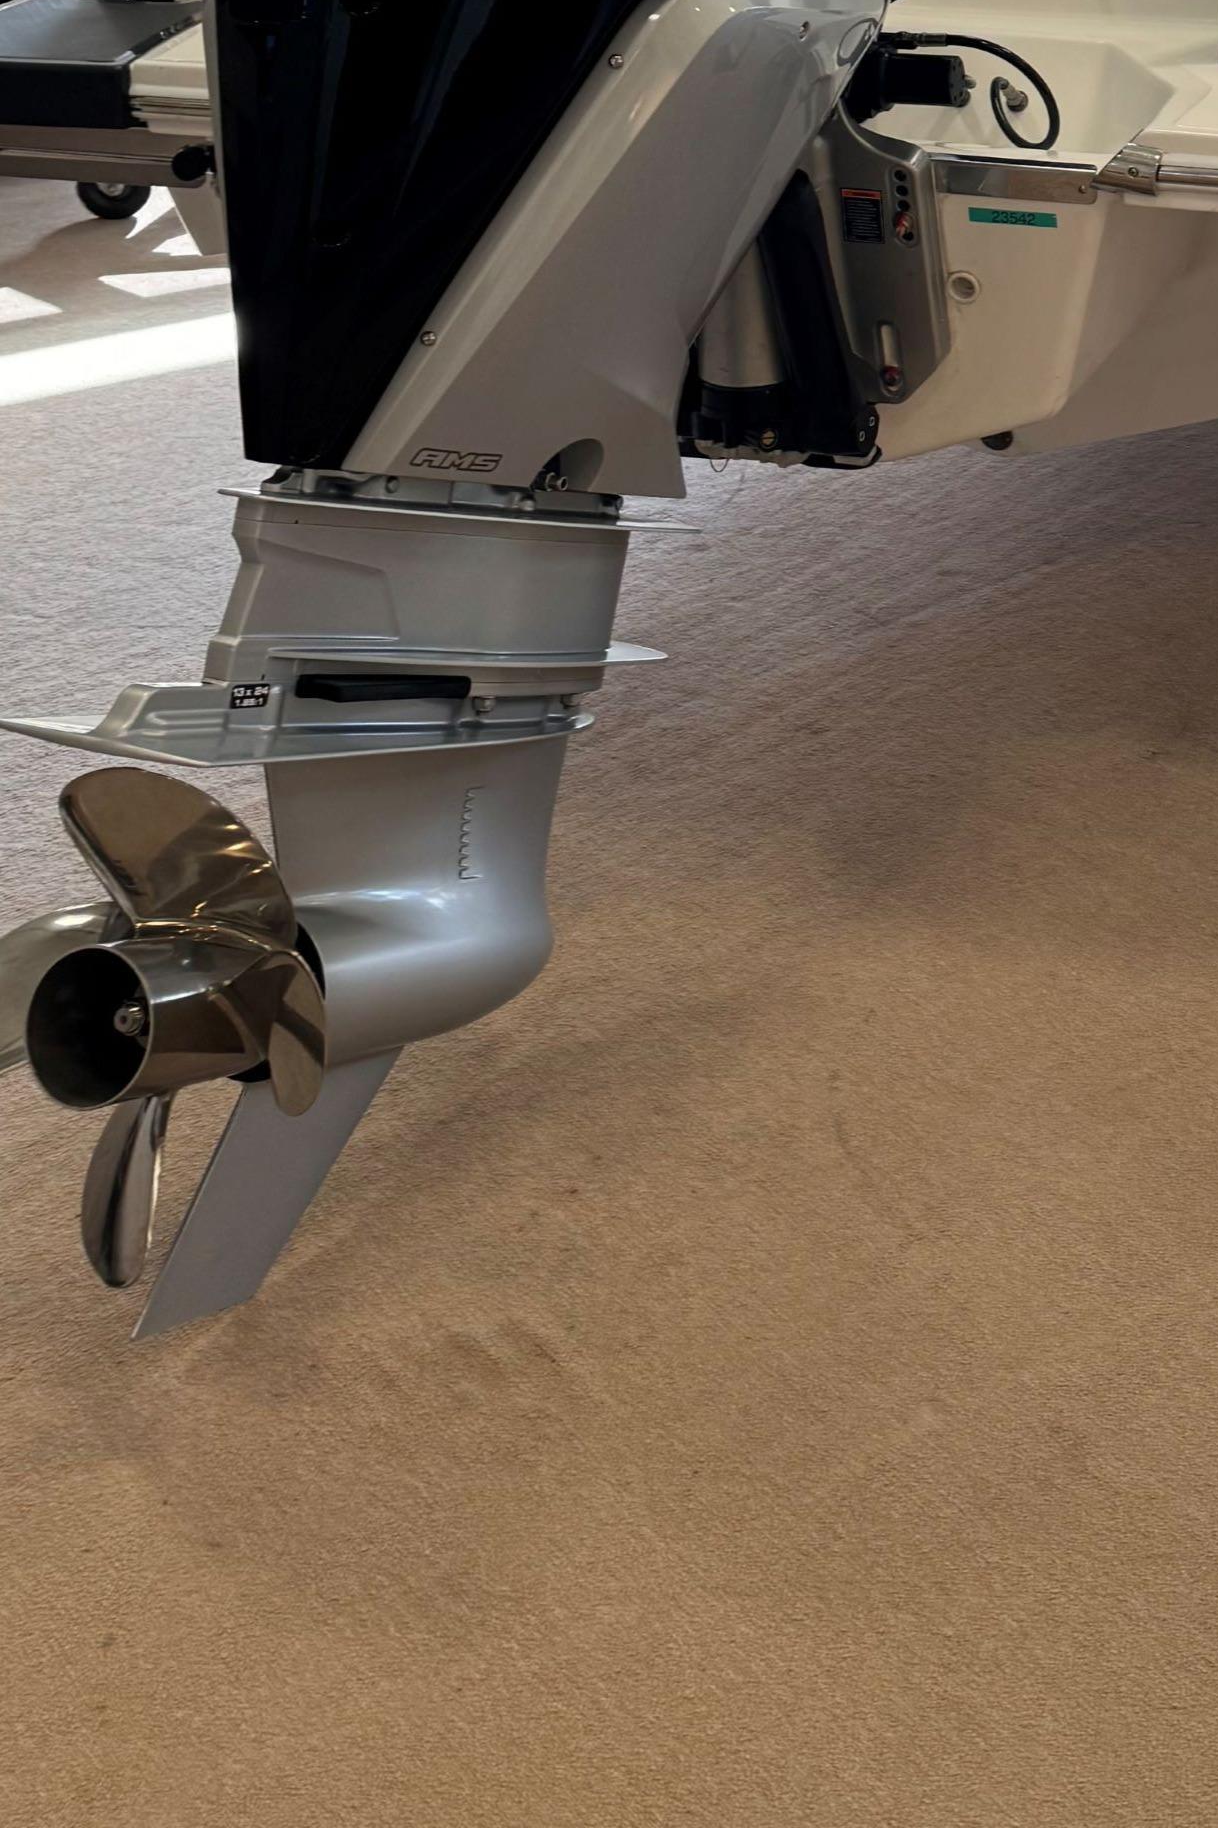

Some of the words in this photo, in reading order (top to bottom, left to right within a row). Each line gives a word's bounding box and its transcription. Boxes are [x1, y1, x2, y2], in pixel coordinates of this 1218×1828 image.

[991, 211, 1036, 226] 23542
[409, 447, 503, 473] AMS
[233, 687, 245, 697] 13
[254, 686, 269, 696] 24
